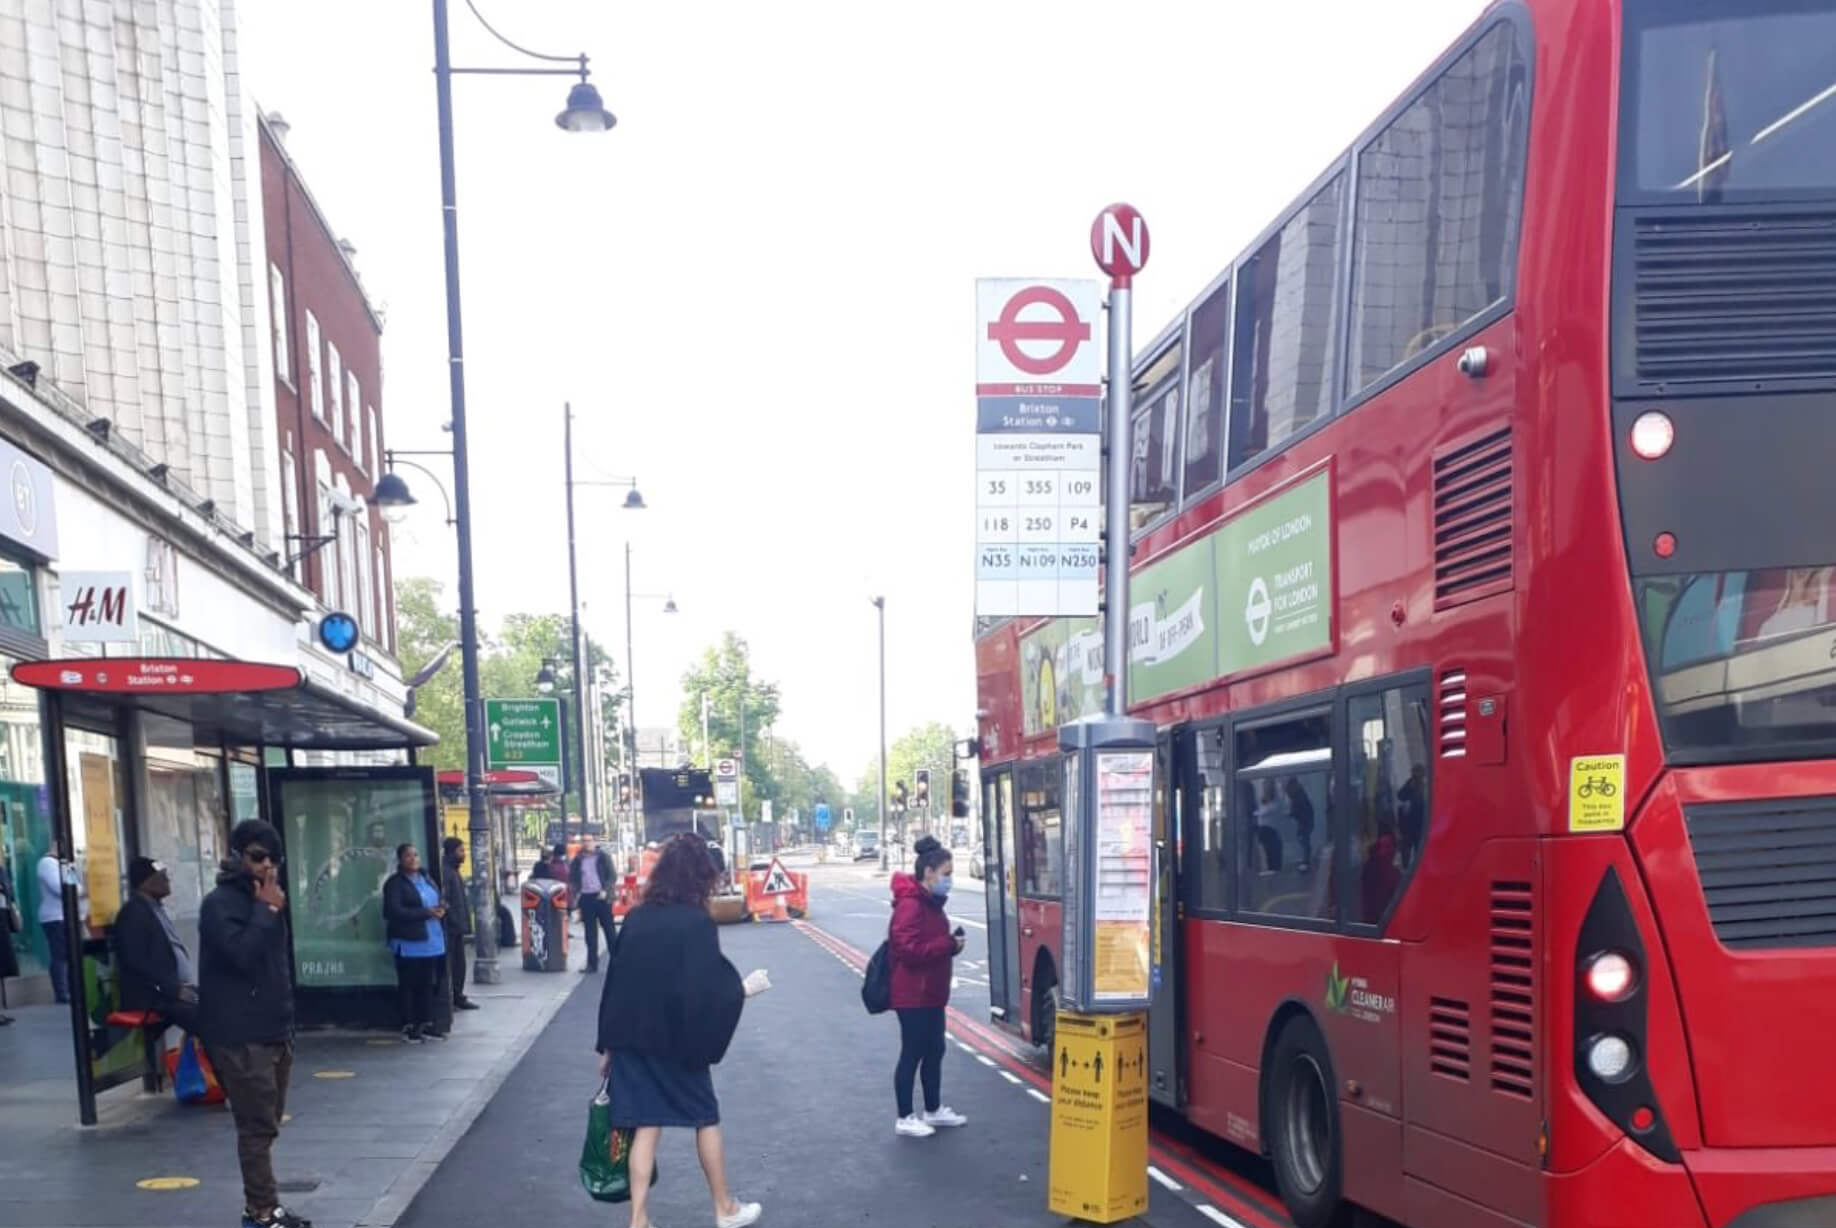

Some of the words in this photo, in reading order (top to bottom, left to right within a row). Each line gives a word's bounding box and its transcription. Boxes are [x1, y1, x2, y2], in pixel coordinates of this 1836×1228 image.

[1104, 212, 1141, 268] N
[1015, 385, 1034, 394] BUS
[1037, 385, 1062, 394] STOP
[1019, 403, 1059, 413] Brixton
[1003, 415, 1041, 426] Station
[988, 480, 1006, 495] 35
[1025, 480, 1053, 495] 355
[1068, 481, 1092, 495] 109
[984, 517, 1009, 531] 118
[1025, 517, 1052, 531] 250
[1070, 517, 1088, 529] P4
[1280, 514, 1312, 540] LONDON
[982, 554, 1011, 567] N35
[1020, 554, 1056, 567] N109
[1061, 554, 1097, 567] N250
[1274, 560, 1312, 588] TRANSPORT
[1288, 583, 1319, 608] LONDON
[68, 586, 127, 627] H&M
[140, 663, 177, 673] Brixton
[128, 674, 164, 685] Station
[501, 703, 540, 713] Brighton
[502, 717, 537, 726] Gatwick
[503, 730, 540, 739] Croydon
[504, 740, 550, 748] Streatham
[1576, 761, 1619, 771] Caution
